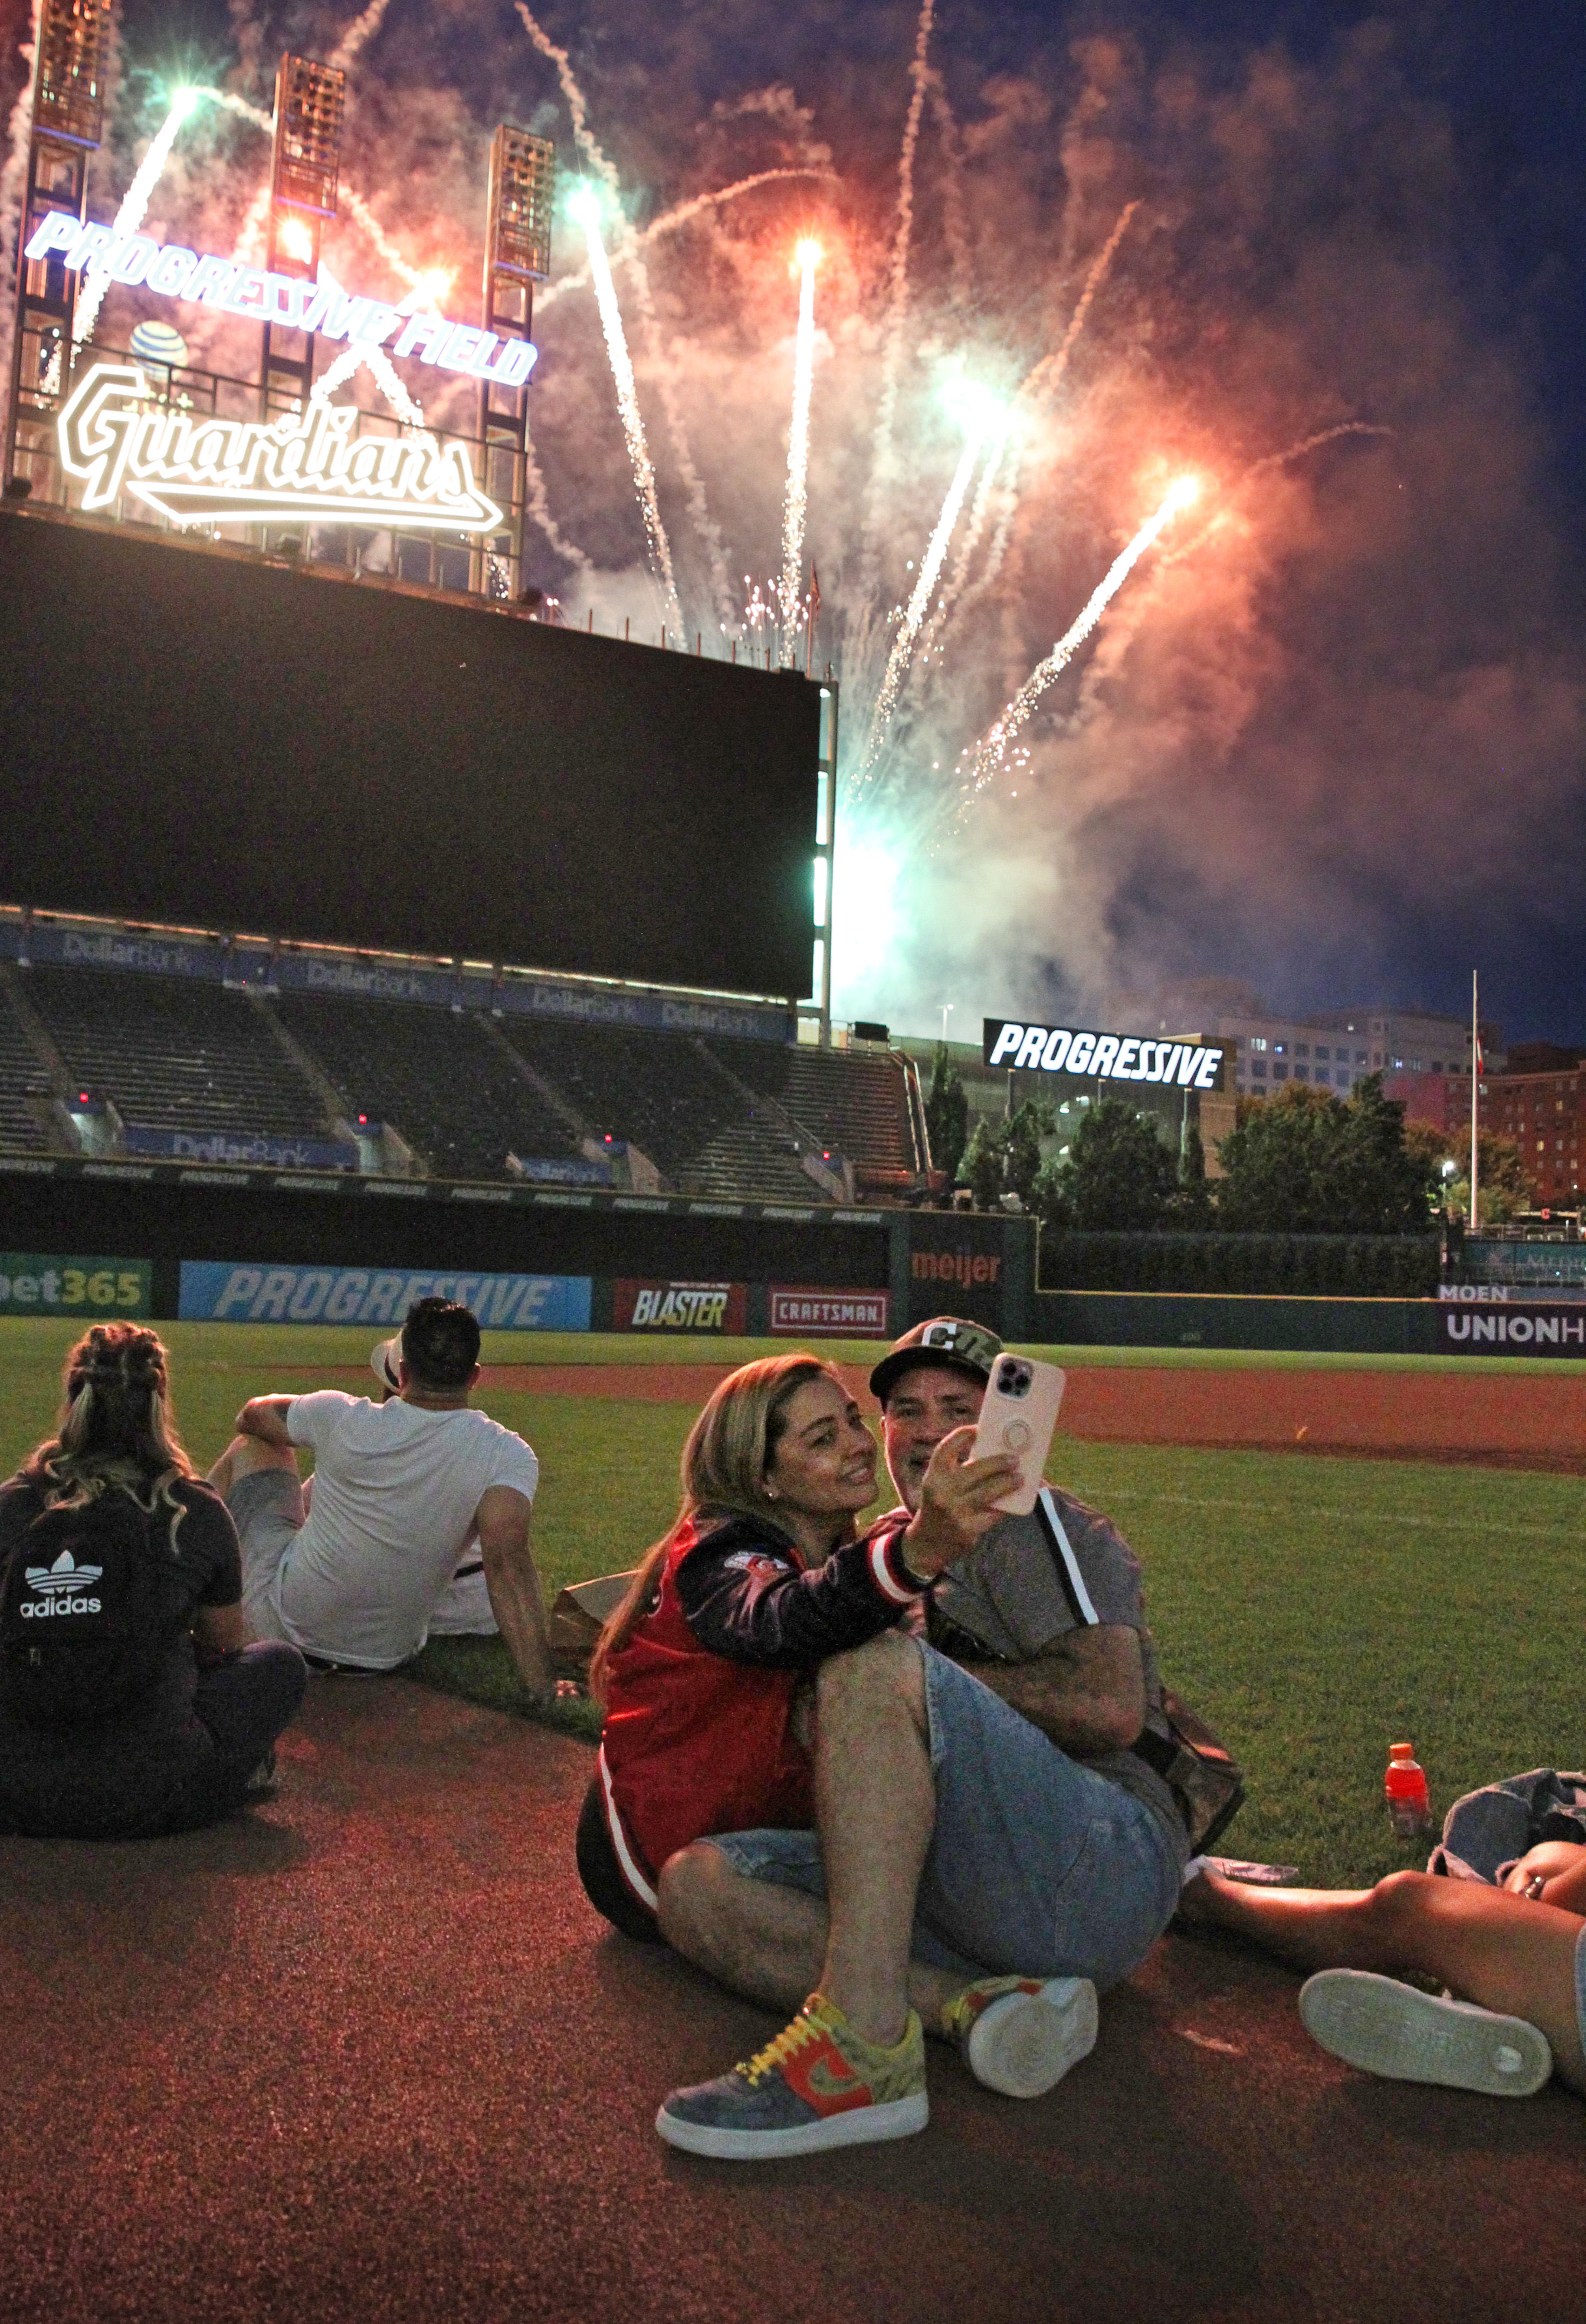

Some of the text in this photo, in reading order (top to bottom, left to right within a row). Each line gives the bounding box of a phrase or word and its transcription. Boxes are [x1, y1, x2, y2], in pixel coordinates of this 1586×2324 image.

[24, 211, 537, 387] PROGRESSIVE FIELD
[58, 363, 480, 509] Guardians
[989, 1023, 1222, 1088] PROGRESSIVE
[912, 1253, 1001, 1289] meijer
[632, 1290, 728, 1328] BLASTER
[1439, 1285, 1507, 1301] MOEN
[779, 1302, 878, 1323] CRAFTSMAN
[1447, 1314, 1584, 1343] UNIONH
[922, 1322, 957, 1349] C
[20, 1595, 101, 1618] adidas
